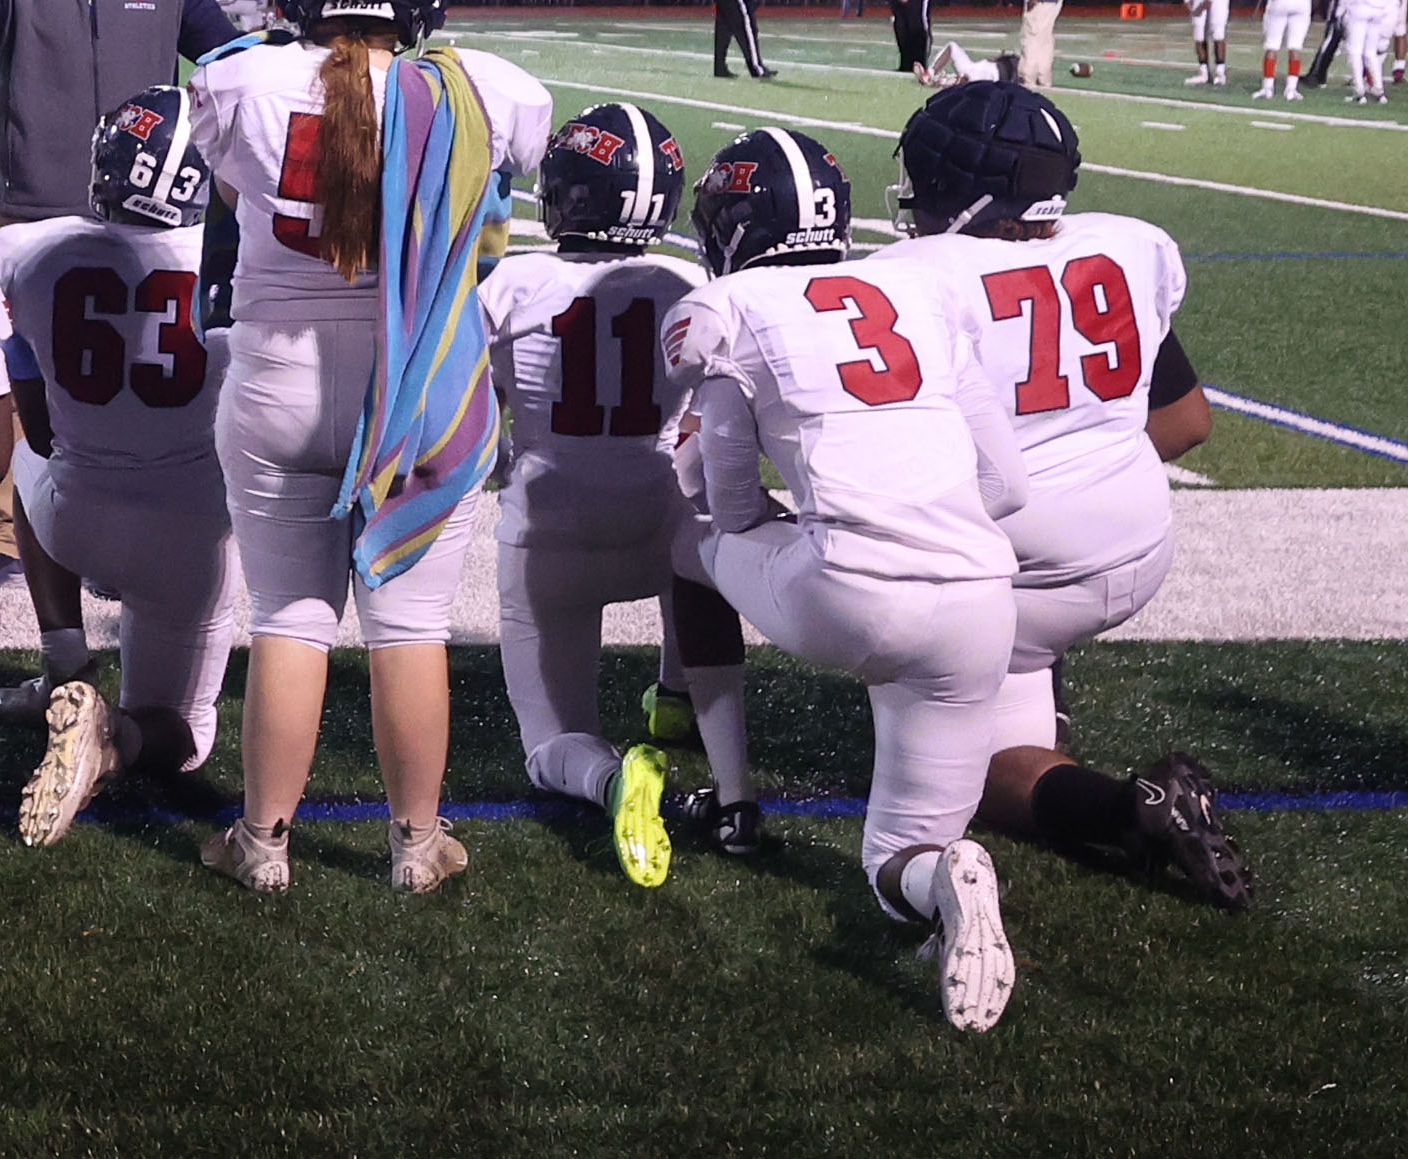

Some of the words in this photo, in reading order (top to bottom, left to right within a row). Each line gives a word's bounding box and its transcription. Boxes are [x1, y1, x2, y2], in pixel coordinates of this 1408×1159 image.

[129, 151, 202, 202] 63
[133, 197, 178, 220] schutt
[607, 222, 655, 239] schutt
[620, 190, 666, 227] 11
[813, 187, 837, 228] 3
[785, 227, 836, 245] schutt
[51, 266, 207, 409] 63
[803, 274, 924, 407] 3
[980, 252, 1143, 417] 79
[550, 294, 662, 437] 11
